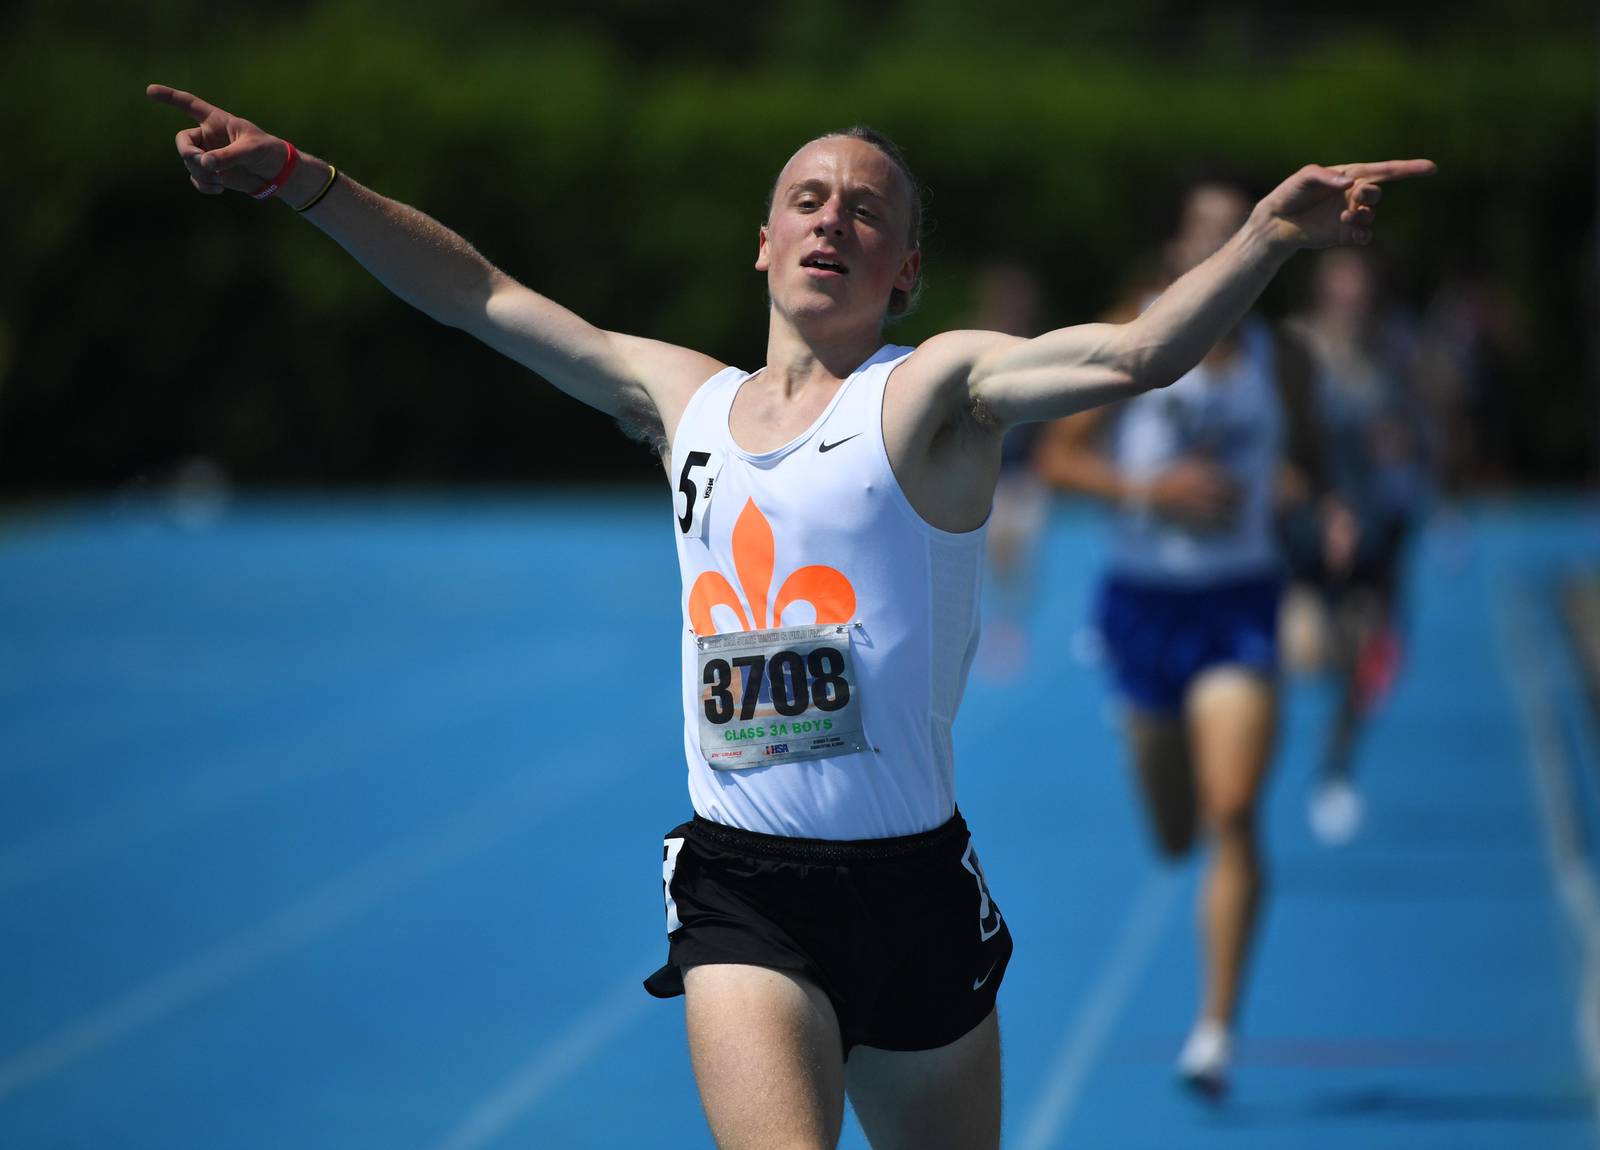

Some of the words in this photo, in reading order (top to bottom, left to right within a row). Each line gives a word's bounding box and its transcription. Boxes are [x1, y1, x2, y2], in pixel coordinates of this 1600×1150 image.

[679, 451, 711, 533] 5
[703, 647, 850, 724] 3708
[724, 726, 765, 741] CLASS
[770, 724, 788, 736] 3A
[792, 719, 833, 733] BOYS
